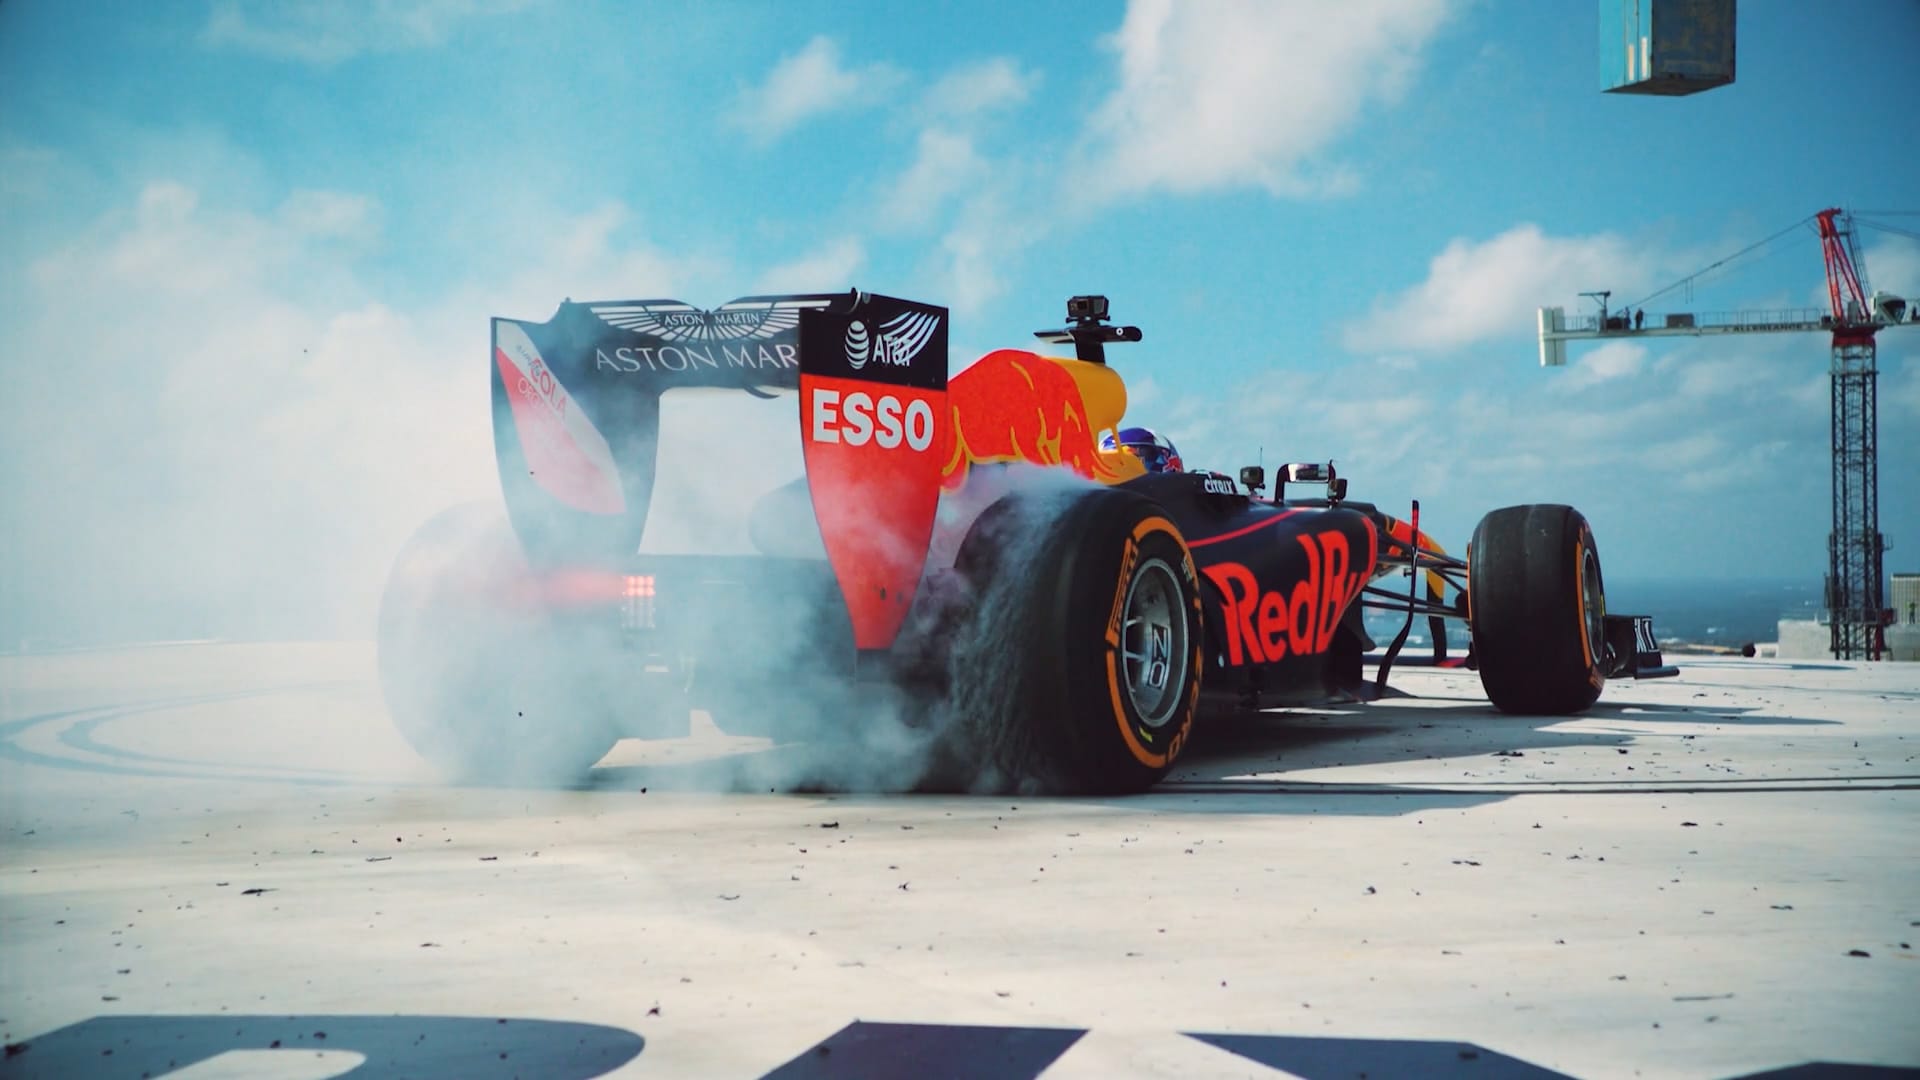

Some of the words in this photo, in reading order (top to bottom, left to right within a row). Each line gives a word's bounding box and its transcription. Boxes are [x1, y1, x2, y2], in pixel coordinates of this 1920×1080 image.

[664, 313, 705, 326] ASTON
[715, 311, 760, 325] MARTIN
[596, 346, 719, 372] ASTON
[722, 343, 799, 369] MAR
[812, 387, 935, 452] ESSO
